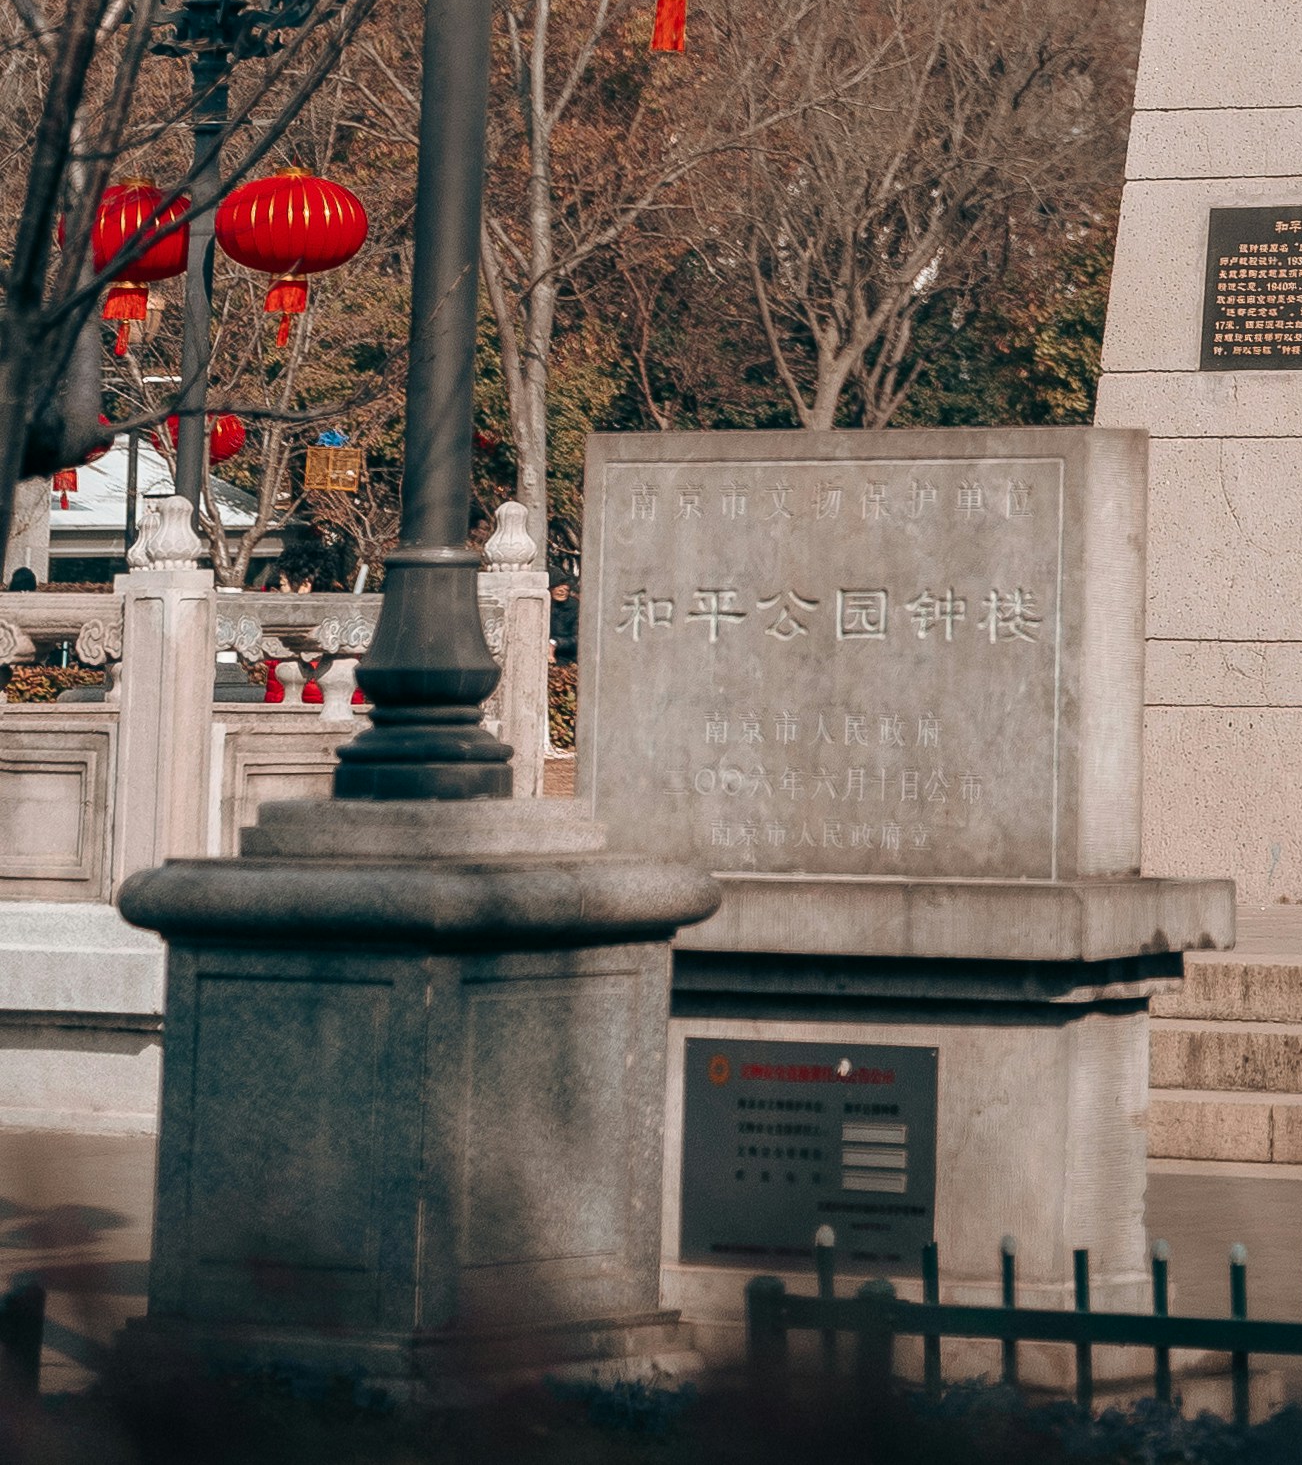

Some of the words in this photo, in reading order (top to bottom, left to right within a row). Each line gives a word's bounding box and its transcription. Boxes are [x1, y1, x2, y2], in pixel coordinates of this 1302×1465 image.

[630, 479, 1035, 521] 南京市文物保护单位
[615, 587, 1043, 644] 和平公园钟楼
[704, 710, 943, 748] 南京市人民政府
[711, 818, 935, 852] 南京市人民政府立
